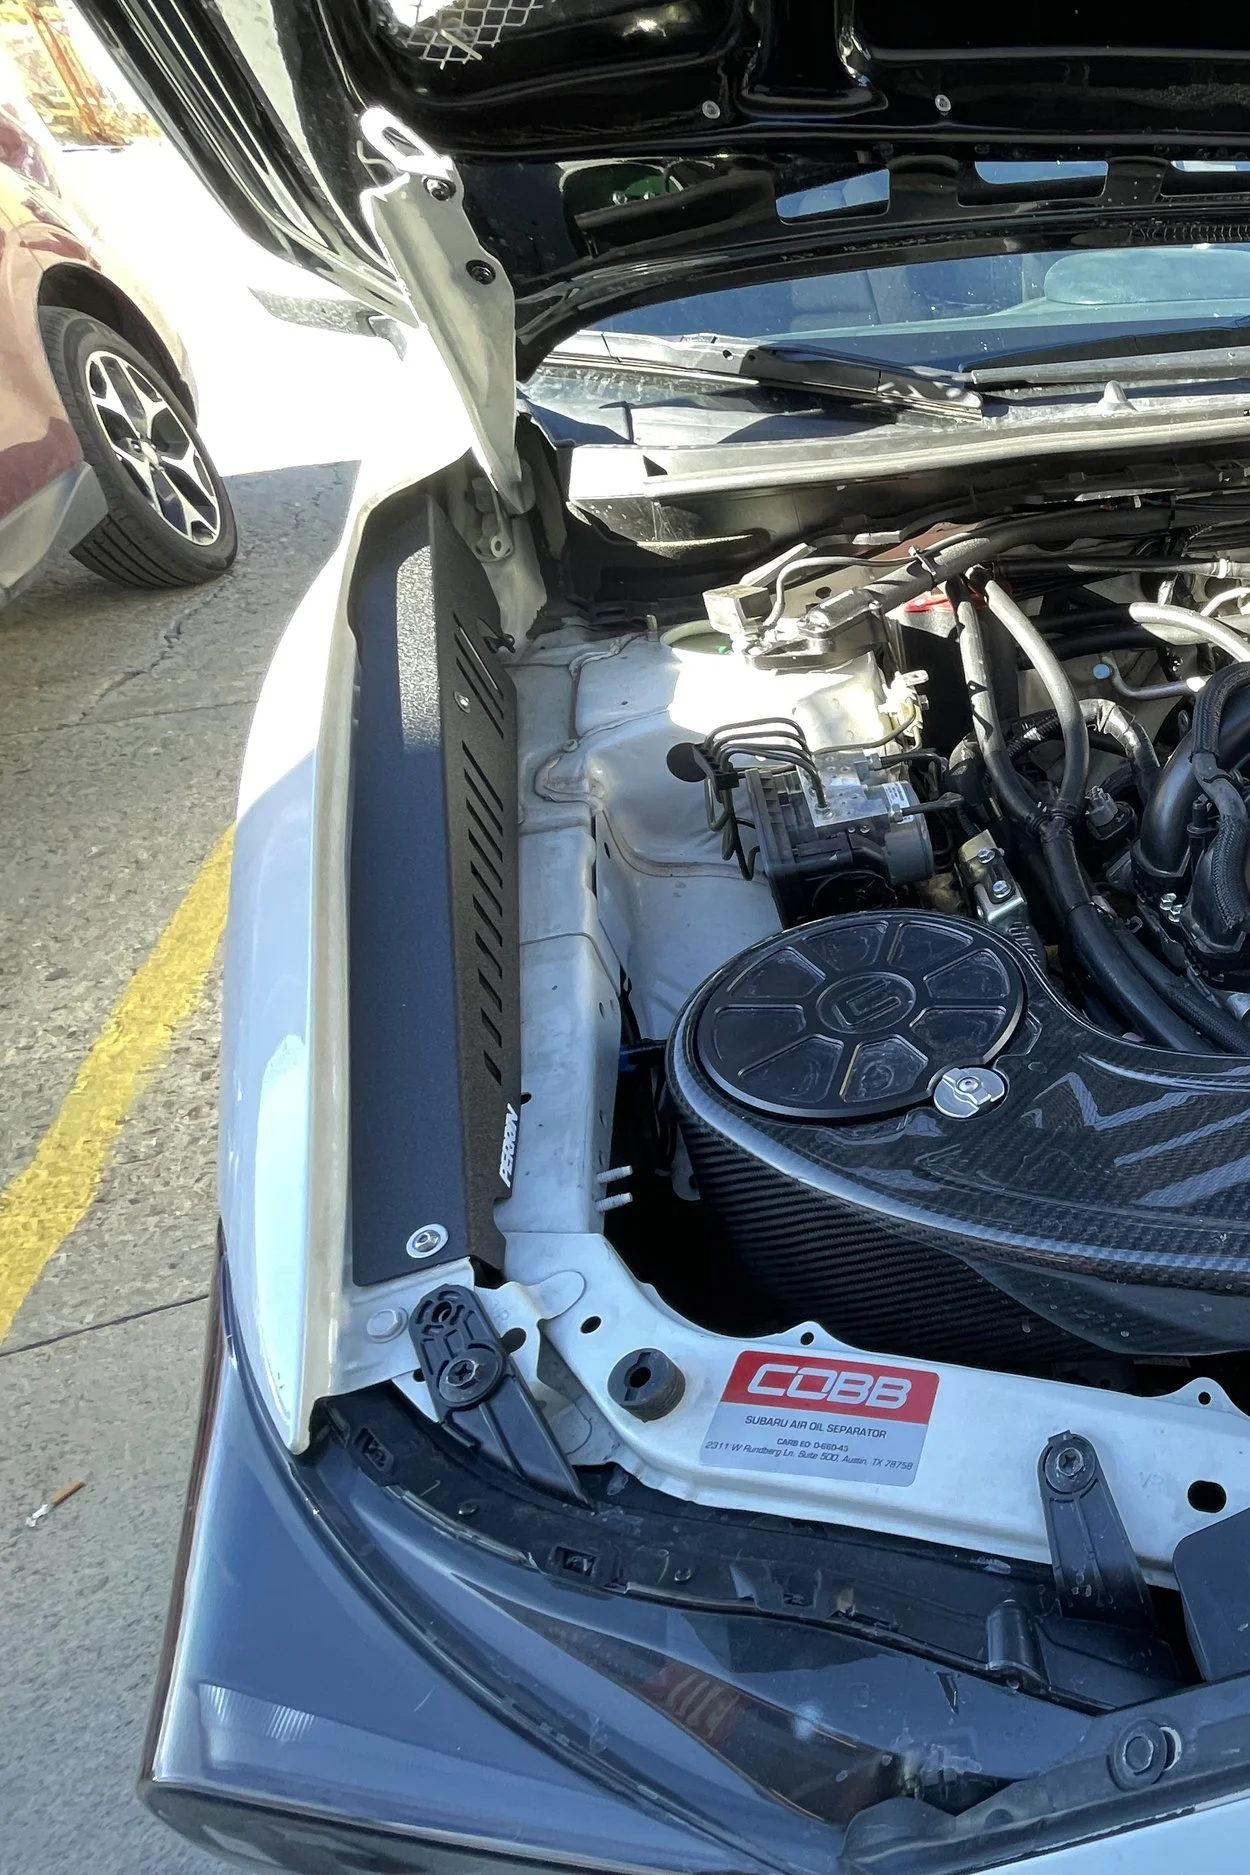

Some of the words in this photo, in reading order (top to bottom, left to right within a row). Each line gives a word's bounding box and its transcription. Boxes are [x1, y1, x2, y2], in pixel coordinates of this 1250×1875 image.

[499, 1103, 518, 1188] PERRIN
[747, 1363, 912, 1409] COBB
[745, 1415, 789, 1428] SUBARU
[789, 1419, 807, 1430] AIR
[809, 1421, 824, 1431] OIL
[826, 1423, 887, 1439] SEPARATOR
[705, 1440, 729, 1450] 2311
[731, 1443, 743, 1451] W
[743, 1444, 782, 1457] Rundberg
[797, 1450, 818, 1459] Suite
[872, 1458, 885, 1467] TX
[885, 1459, 914, 1470] 78758
[776, 1438, 799, 1447] CARB
